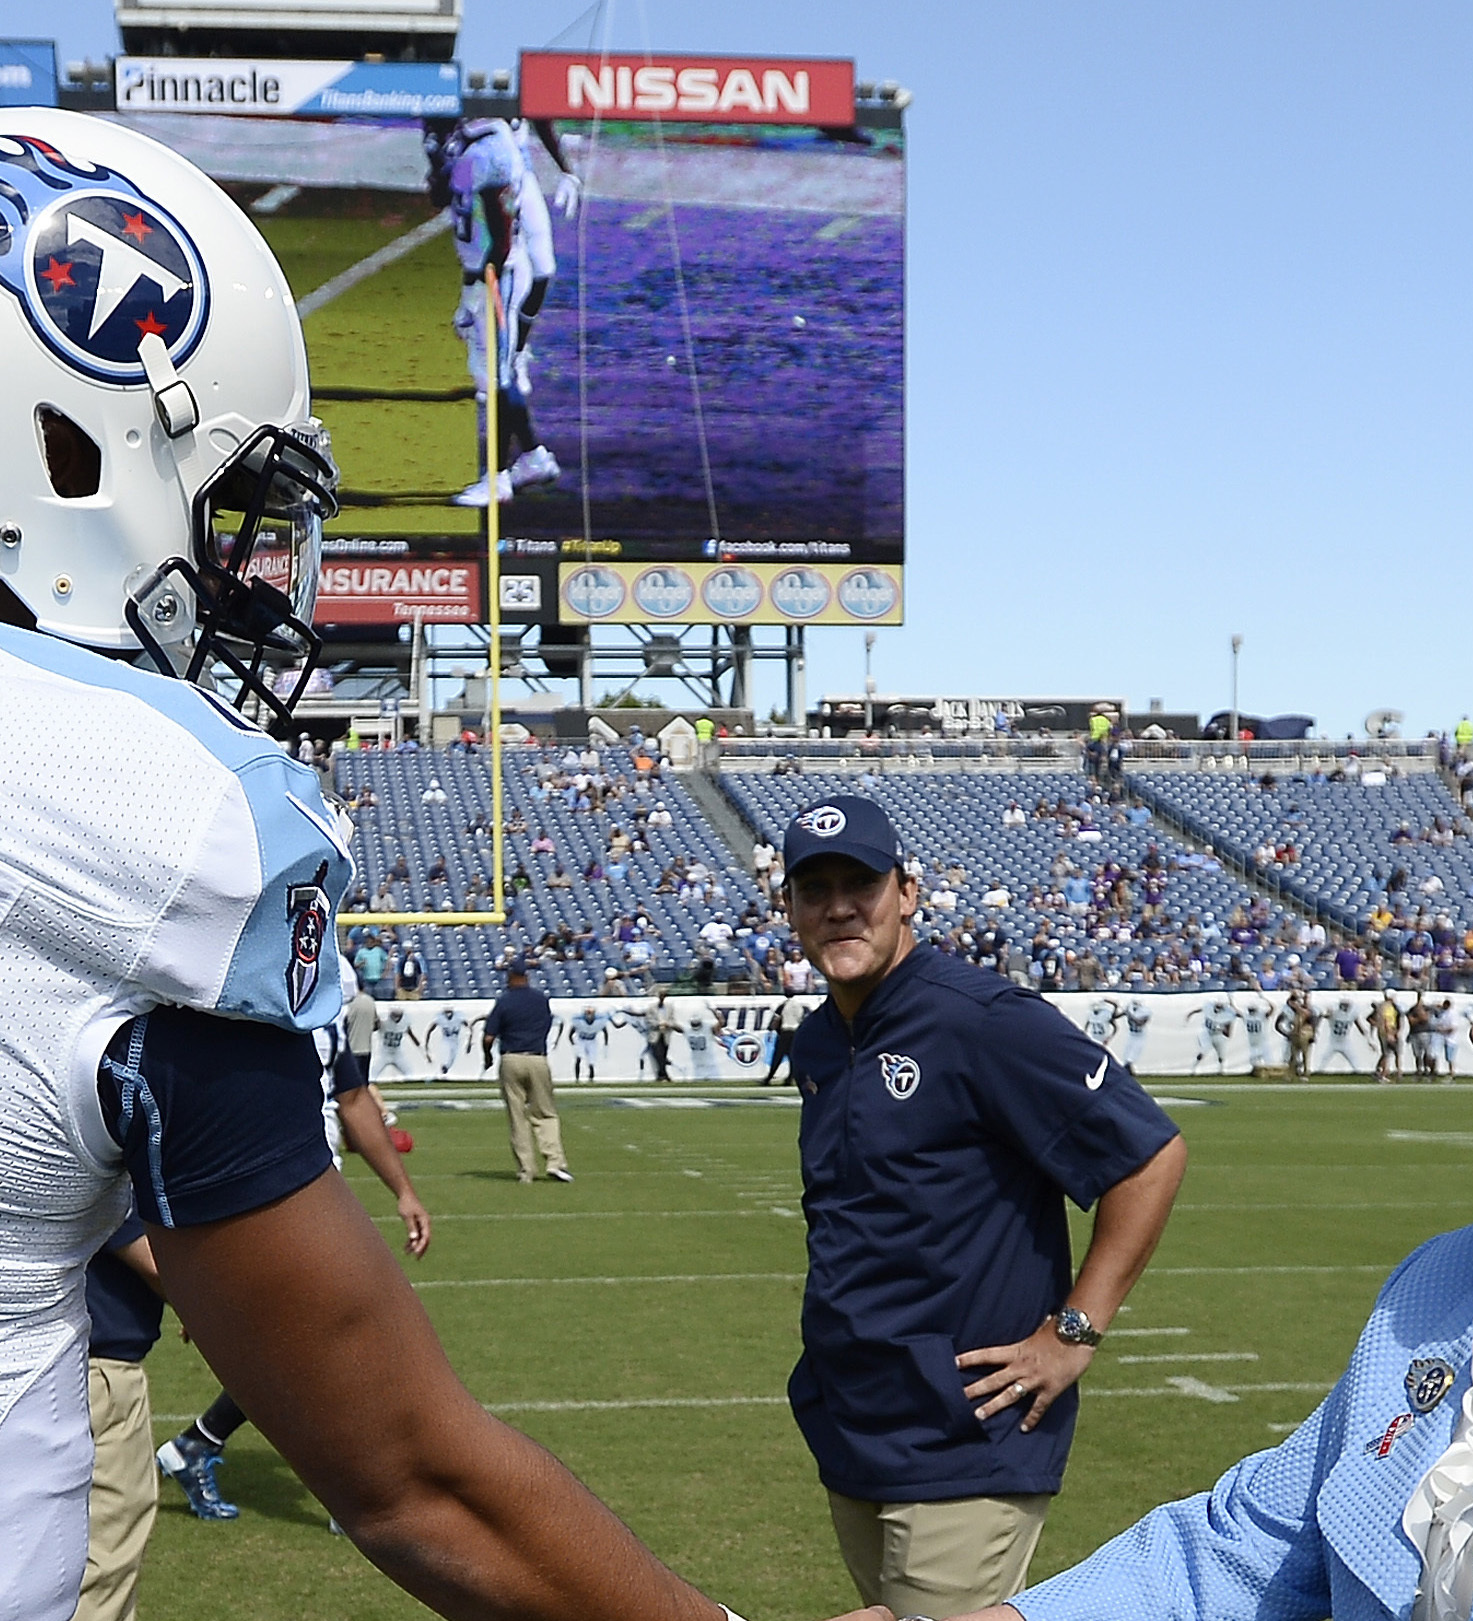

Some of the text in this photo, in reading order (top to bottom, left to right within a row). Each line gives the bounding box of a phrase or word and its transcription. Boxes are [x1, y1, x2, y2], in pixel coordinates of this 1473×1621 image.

[125, 66, 281, 105] Pinnacle
[567, 64, 811, 115] NISSAN
[318, 567, 469, 596] NSURANCE
